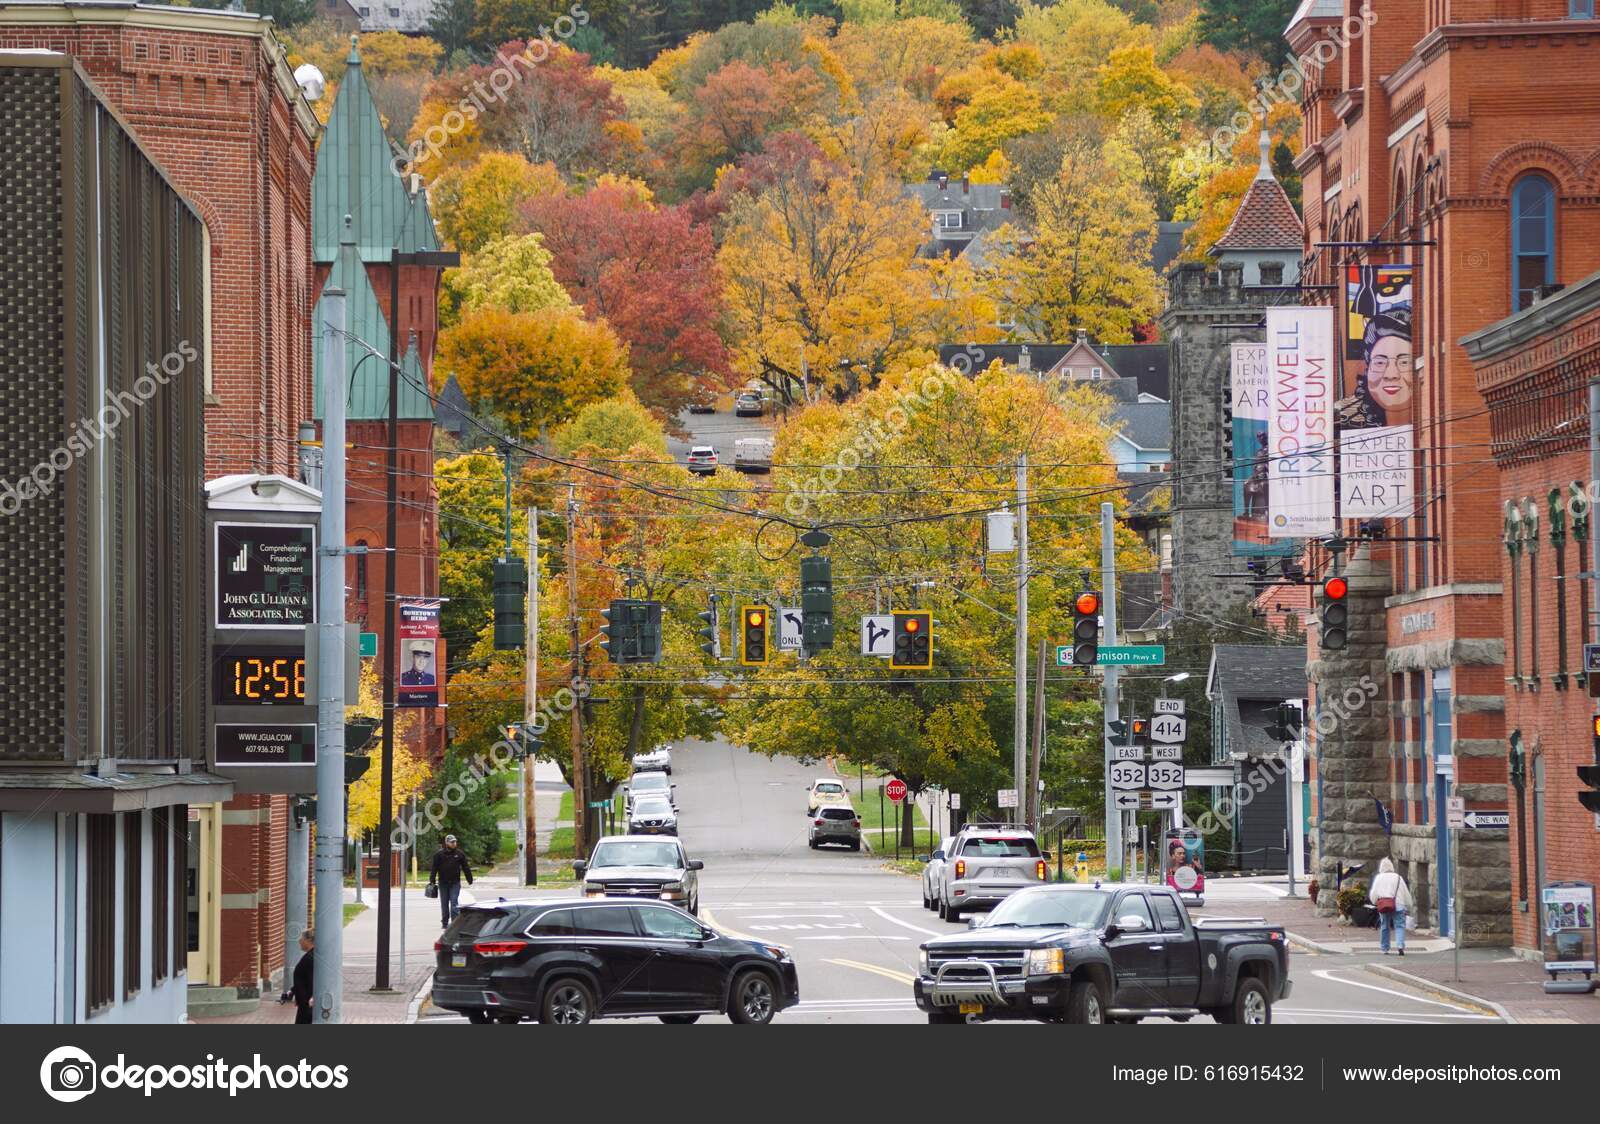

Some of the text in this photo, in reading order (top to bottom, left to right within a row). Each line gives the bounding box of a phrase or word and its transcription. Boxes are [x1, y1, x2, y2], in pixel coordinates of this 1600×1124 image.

[1236, 348, 1266, 361] EXP
[1237, 363, 1268, 376] IEN
[1237, 389, 1269, 408] AR
[1277, 320, 1300, 473] ROCKWELL
[1304, 358, 1326, 473] MUSEUM
[1347, 436, 1407, 450] EXPER
[1347, 454, 1407, 468] IENCE
[1347, 472, 1407, 480] AMERICAN
[1347, 484, 1407, 506] ART
[260, 543, 307, 553] Comprehensive
[270, 554, 297, 562] Financial
[263, 564, 304, 574] Management
[224, 593, 248, 604] JOHN
[249, 593, 260, 604] G.
[261, 593, 300, 605] ULLMAN
[228, 607, 304, 619] ASSOCIATES, INC.
[1061, 651, 1073, 660] 35
[1097, 651, 1130, 660] enison
[1160, 702, 1179, 711] END
[1155, 722, 1181, 736] 414
[238, 733, 292, 741] WWW.JGUA.COM
[245, 745, 285, 753] 607.936.3785
[1119, 749, 1138, 758] EAST
[1156, 748, 1177, 757] WEST
[1113, 769, 1143, 783] 352
[1151, 769, 1182, 783] 352
[887, 786, 905, 795] STOP
